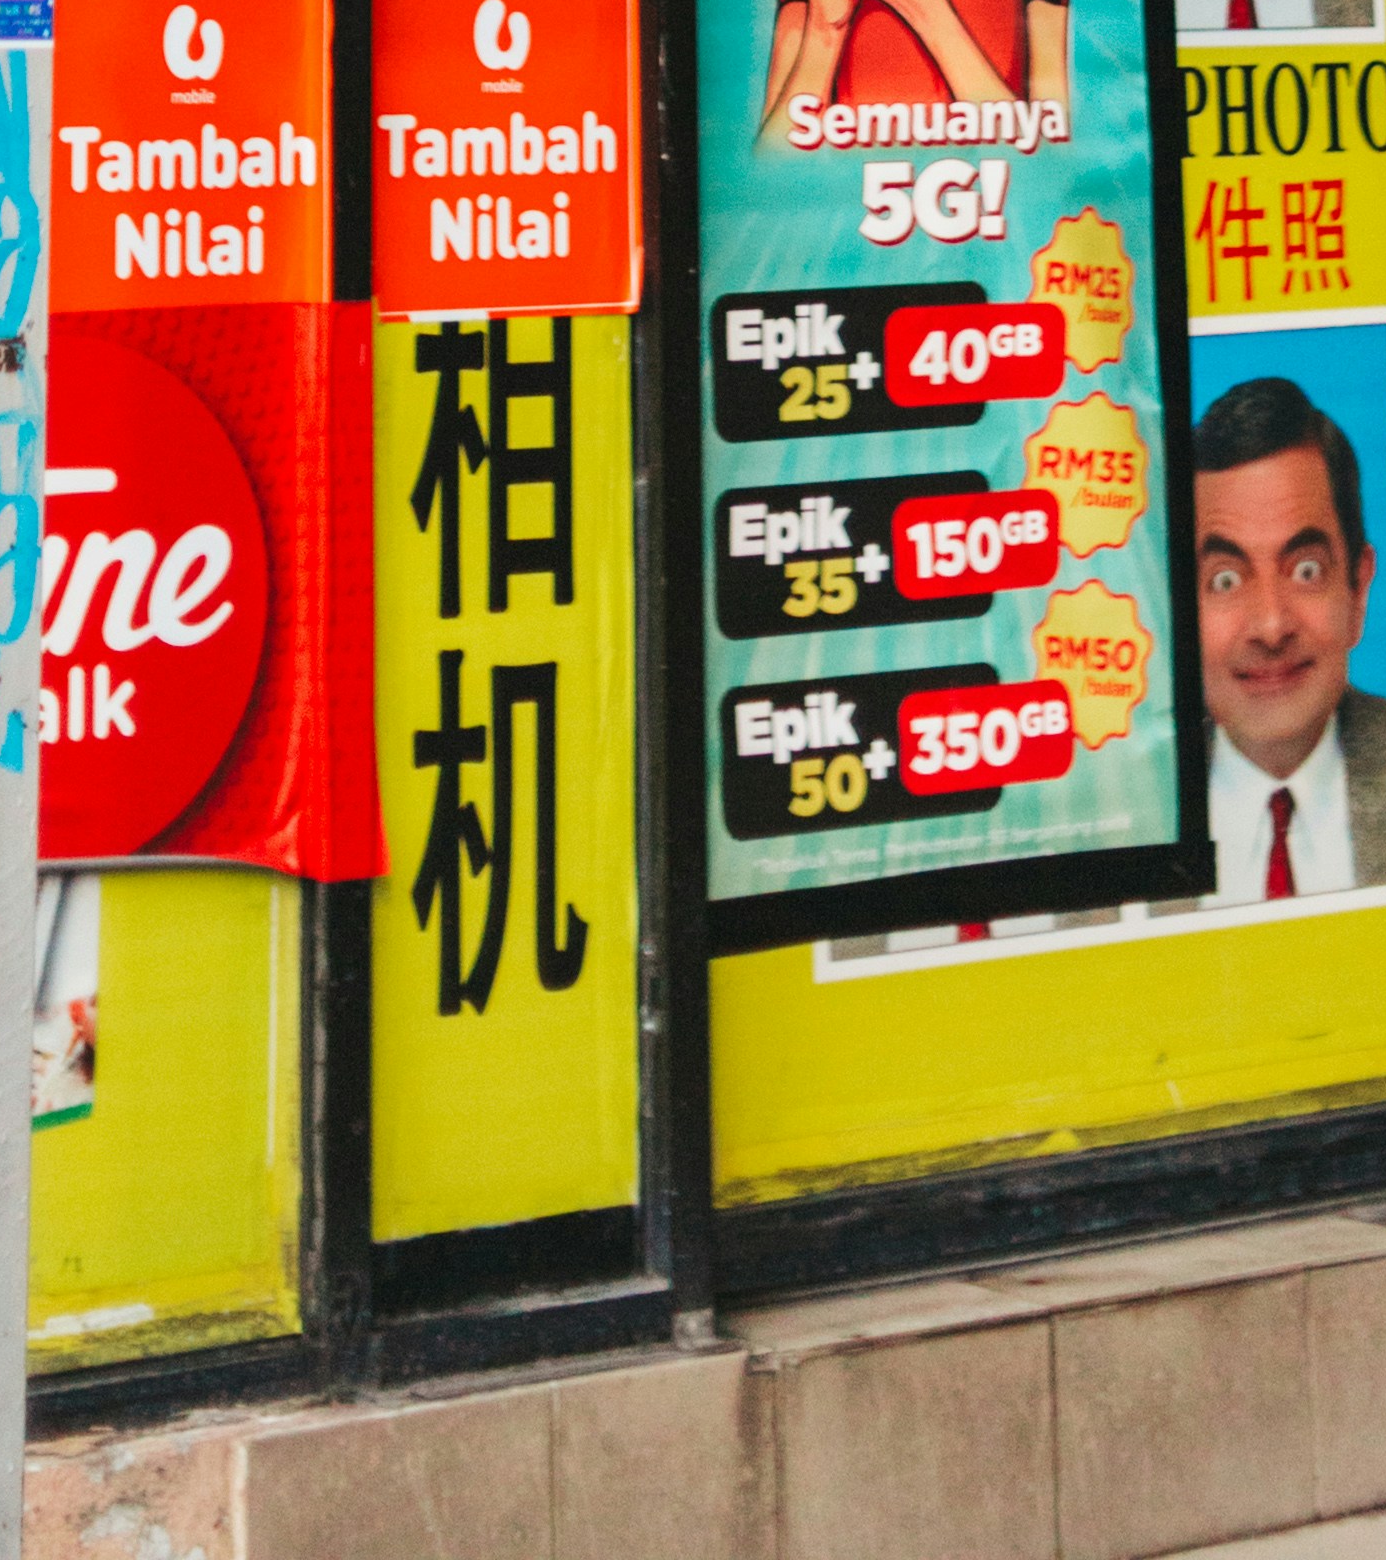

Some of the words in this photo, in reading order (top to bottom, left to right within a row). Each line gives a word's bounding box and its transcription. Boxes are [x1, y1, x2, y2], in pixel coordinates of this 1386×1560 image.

[169, 87, 215, 106] mobile
[481, 78, 524, 95] mobile
[377, 112, 618, 178] Tambah
[788, 92, 1070, 153] Semuanya
[58, 123, 318, 194] Tambah
[429, 193, 572, 264] Nilai
[859, 157, 1010, 246] 5G!
[112, 210, 265, 283] Nilai
[1195, 176, 1351, 303] 件照
[1044, 260, 1121, 301] RM25
[726, 303, 846, 370] Epik
[1038, 445, 1135, 485] RM35
[729, 494, 852, 566] Epik
[1044, 635, 1137, 673] RM50
[735, 690, 860, 764] Epik
